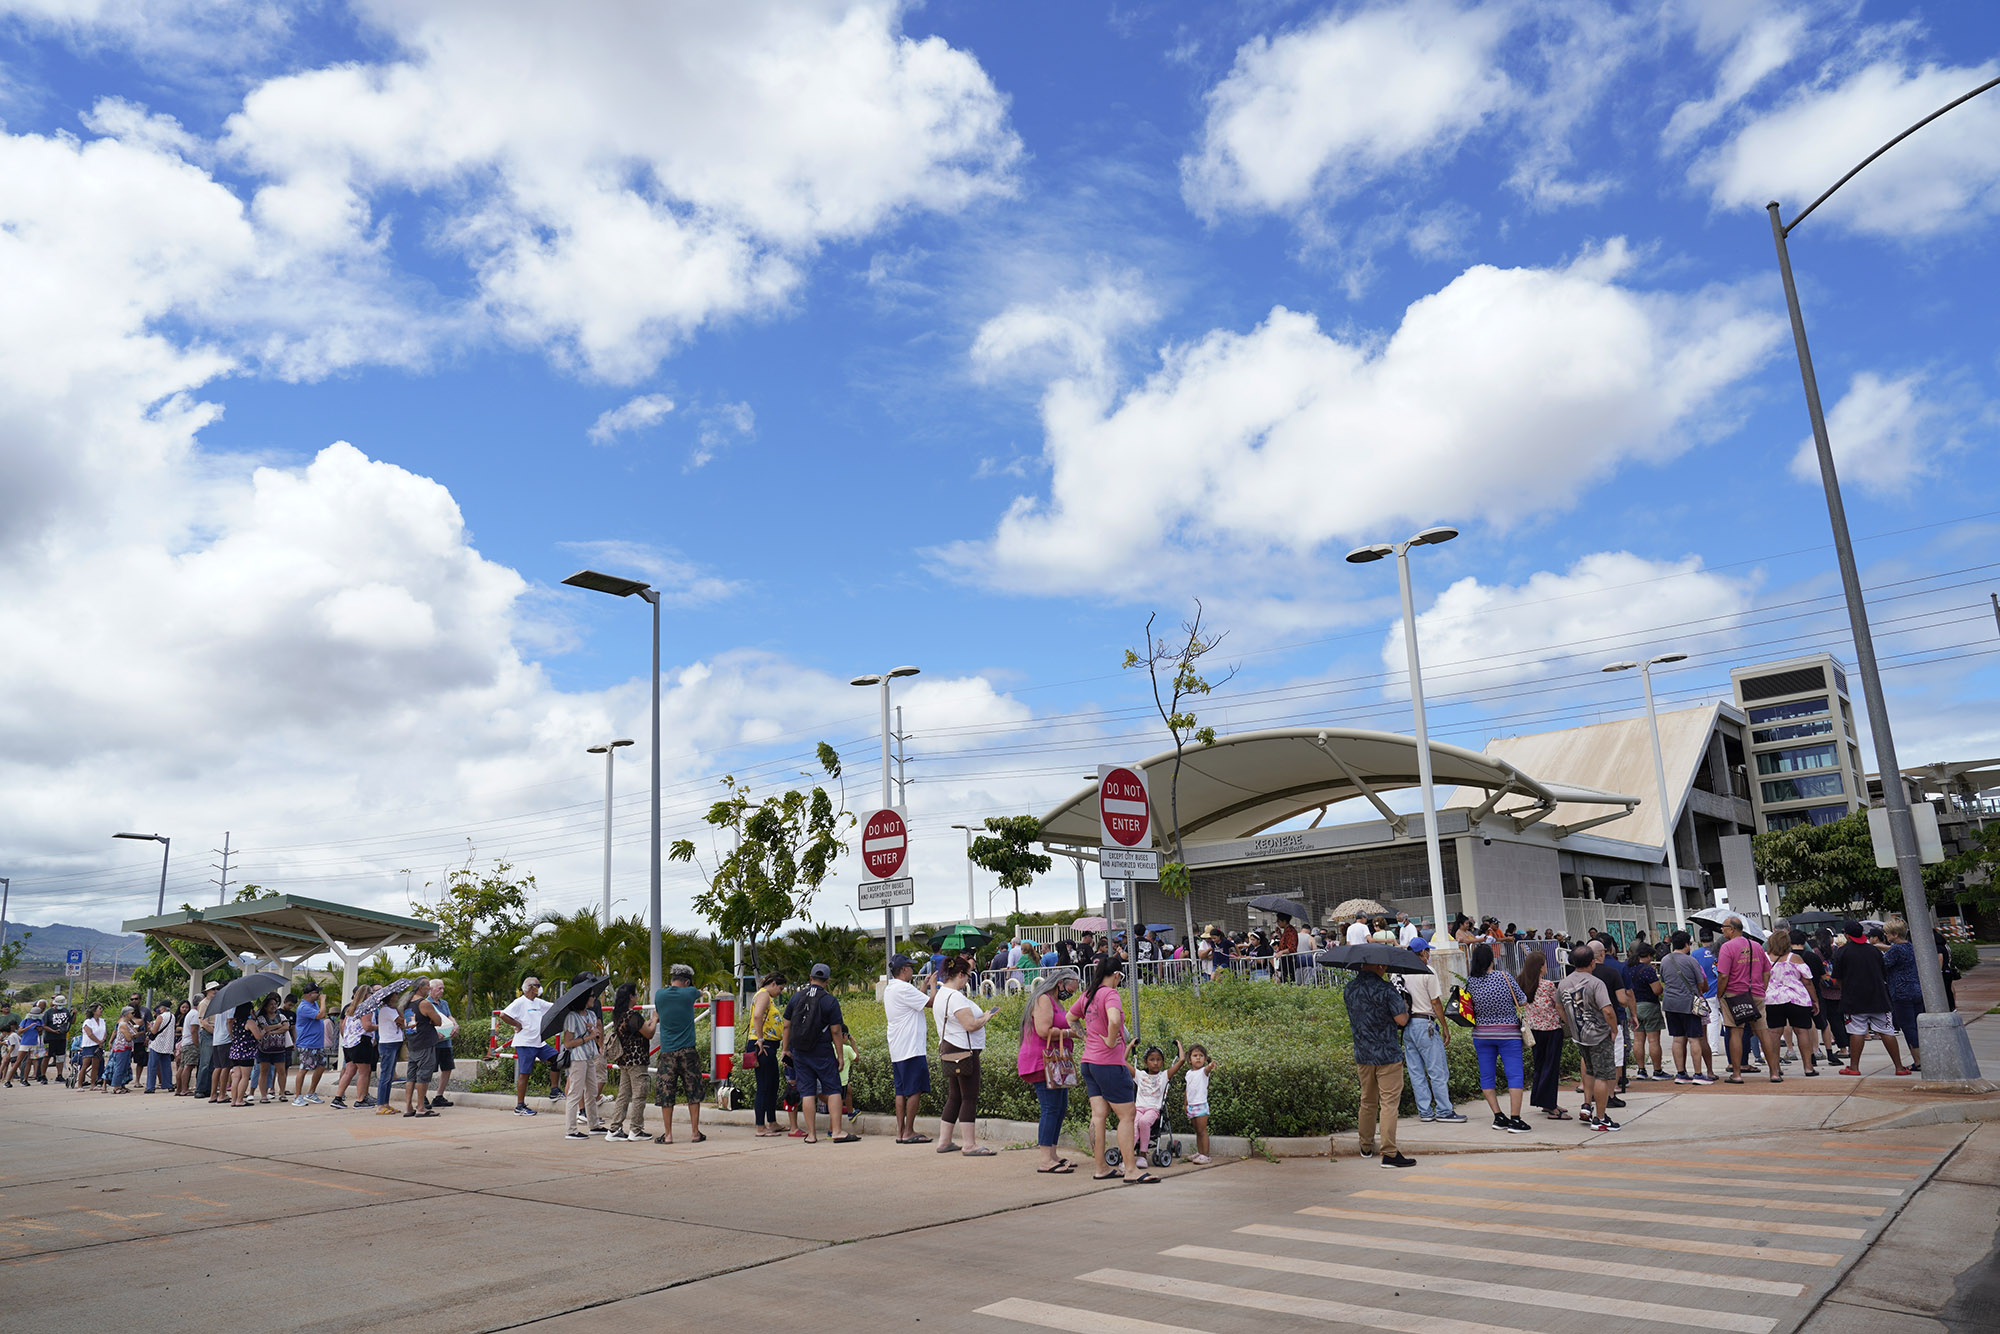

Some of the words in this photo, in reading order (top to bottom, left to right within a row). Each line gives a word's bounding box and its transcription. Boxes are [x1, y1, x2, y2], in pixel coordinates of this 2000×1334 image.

[1107, 782, 1119, 794] DO
[1124, 784, 1140, 797] NOT
[868, 824, 880, 836] DO
[884, 821, 900, 833] NOT
[1112, 818, 1140, 831] ENTER
[871, 853, 897, 866] ENTER
[1109, 852, 1124, 860] EXCEPT
[1111, 861, 1136, 869] AUTHORIZED
[1137, 862, 1156, 870] VEHICLES
[1124, 869, 1134, 877] ONLY
[867, 885, 881, 893] EXCEPT
[892, 882, 904, 890] BUSES
[869, 891, 892, 899] AUTHORIZED
